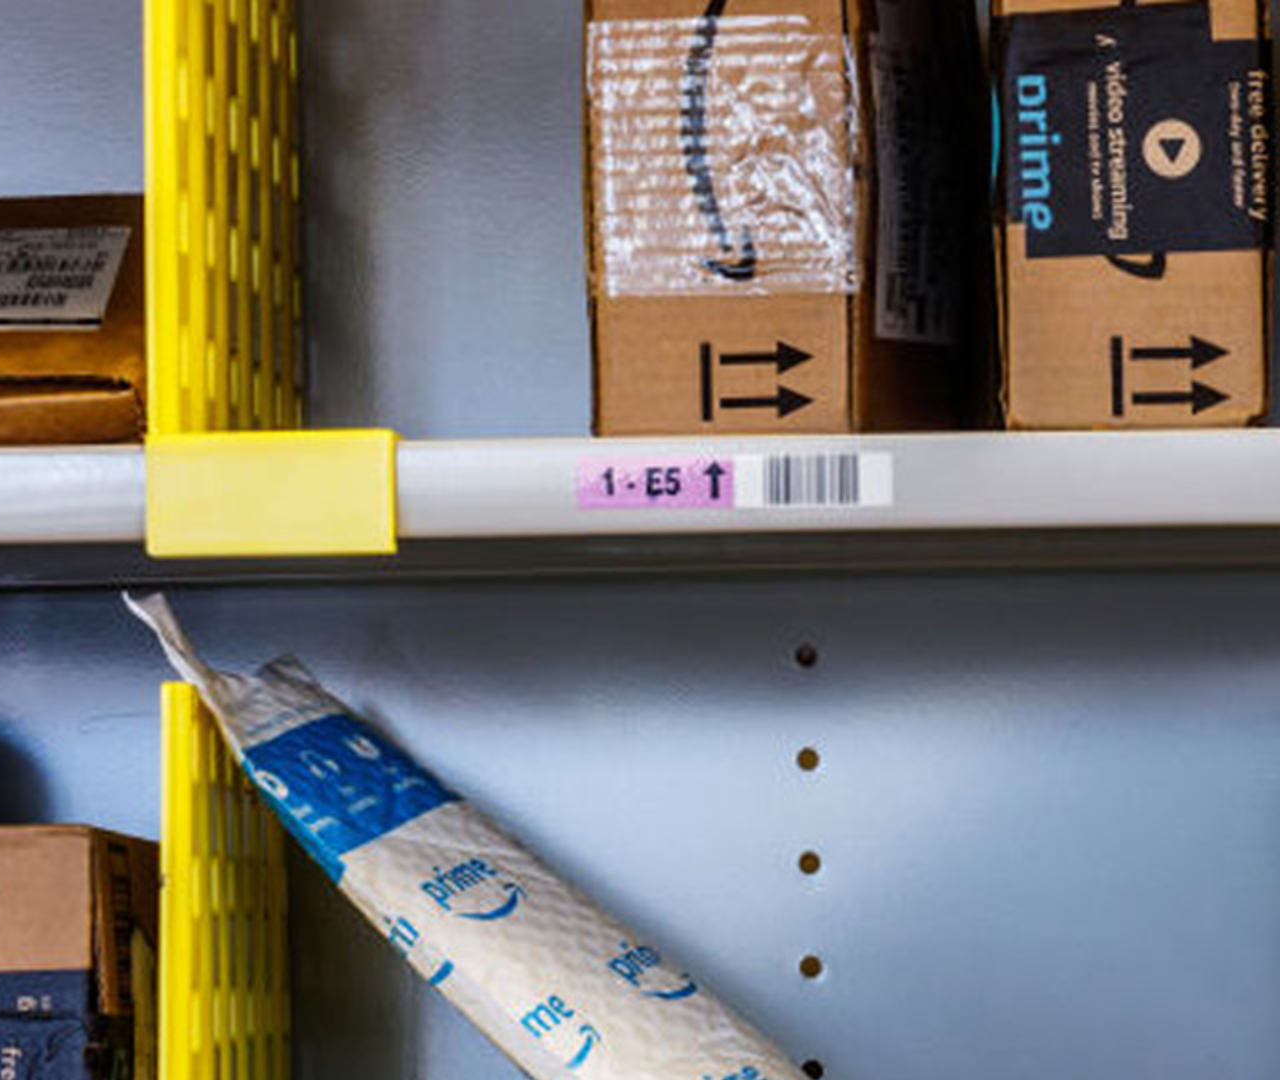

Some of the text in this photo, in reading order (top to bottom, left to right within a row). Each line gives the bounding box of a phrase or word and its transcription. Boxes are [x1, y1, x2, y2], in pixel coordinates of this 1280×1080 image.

[1106, 62, 1131, 240] video streaming
[1248, 70, 1269, 220] free delivery
[647, 469, 680, 496] E5
[421, 858, 496, 911] prime
